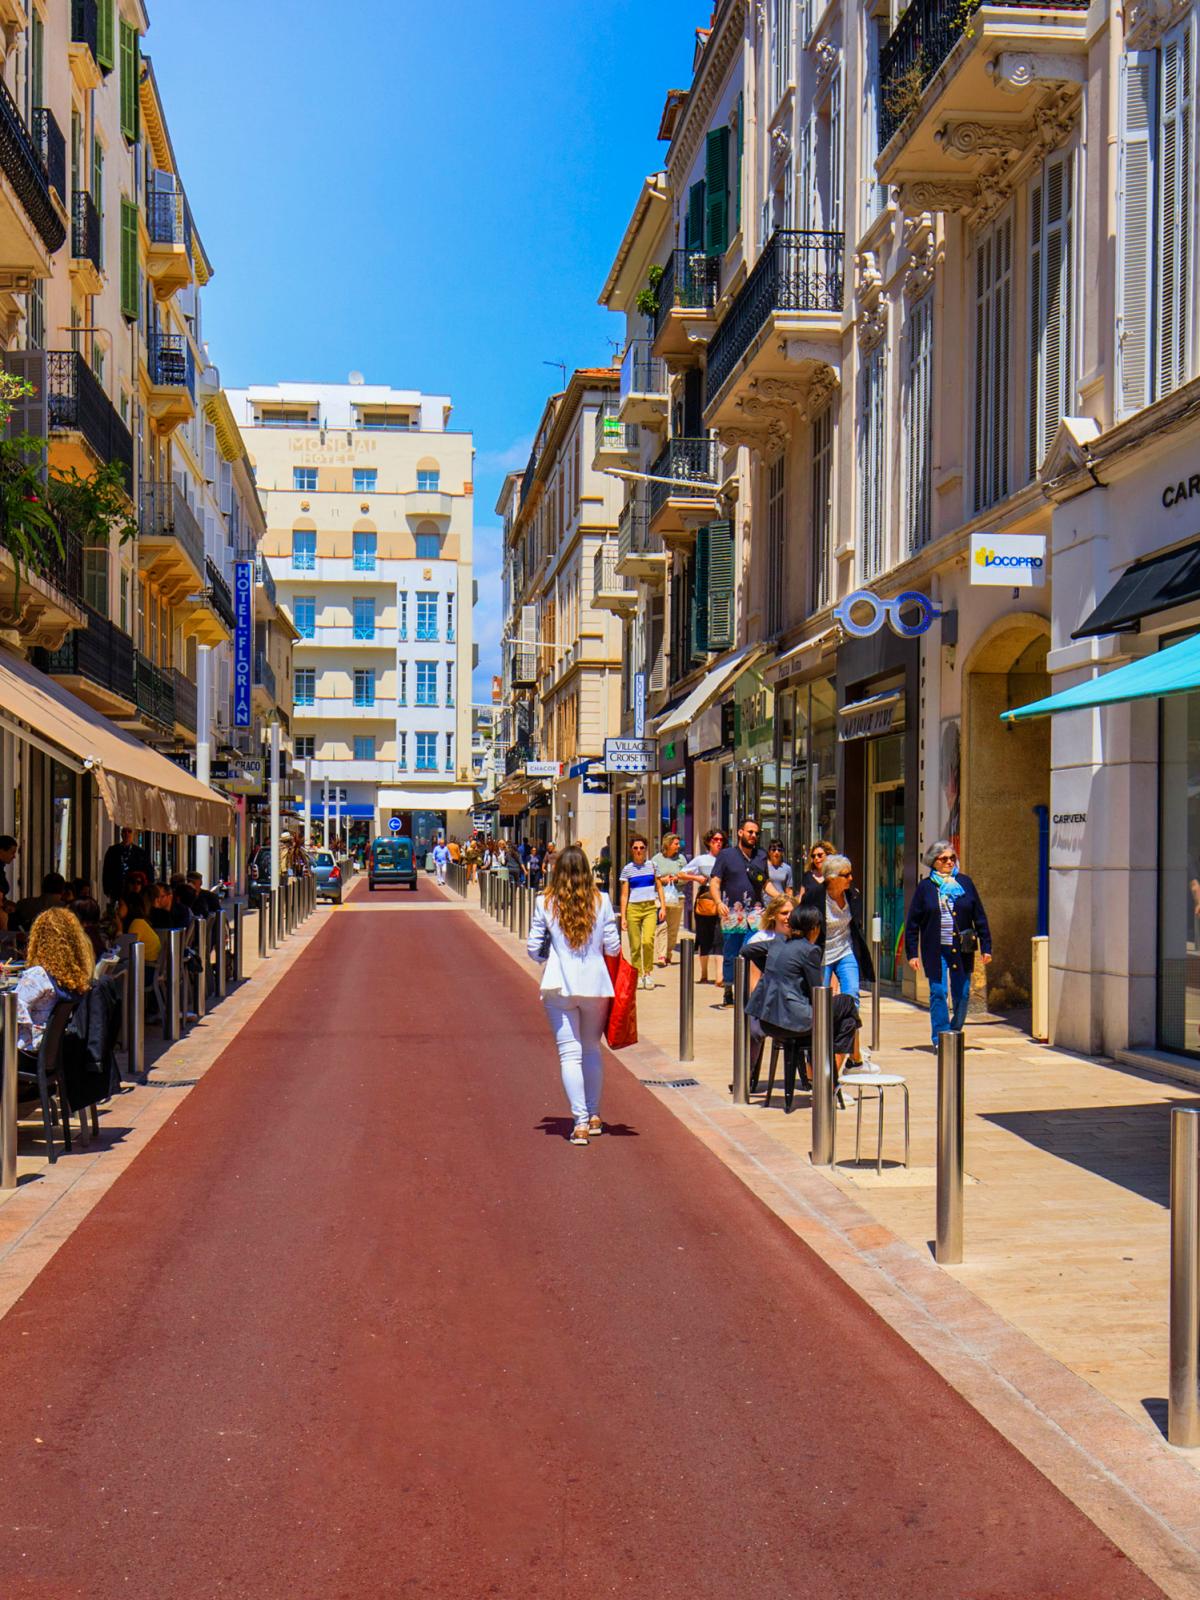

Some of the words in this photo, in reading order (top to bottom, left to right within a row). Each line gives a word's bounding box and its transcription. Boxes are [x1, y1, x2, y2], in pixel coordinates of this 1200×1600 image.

[289, 437, 376, 452] MONDIAL
[301, 453, 355, 463] HOTEL
[1162, 474, 1200, 508] CAR
[985, 555, 1043, 568] LOCOPRO
[236, 566, 250, 628] HOTEL
[236, 637, 249, 724] FLORIAN
[615, 741, 649, 750] VILLAGE
[609, 753, 653, 762] CROISETTE
[1053, 813, 1087, 824] CARVEN
